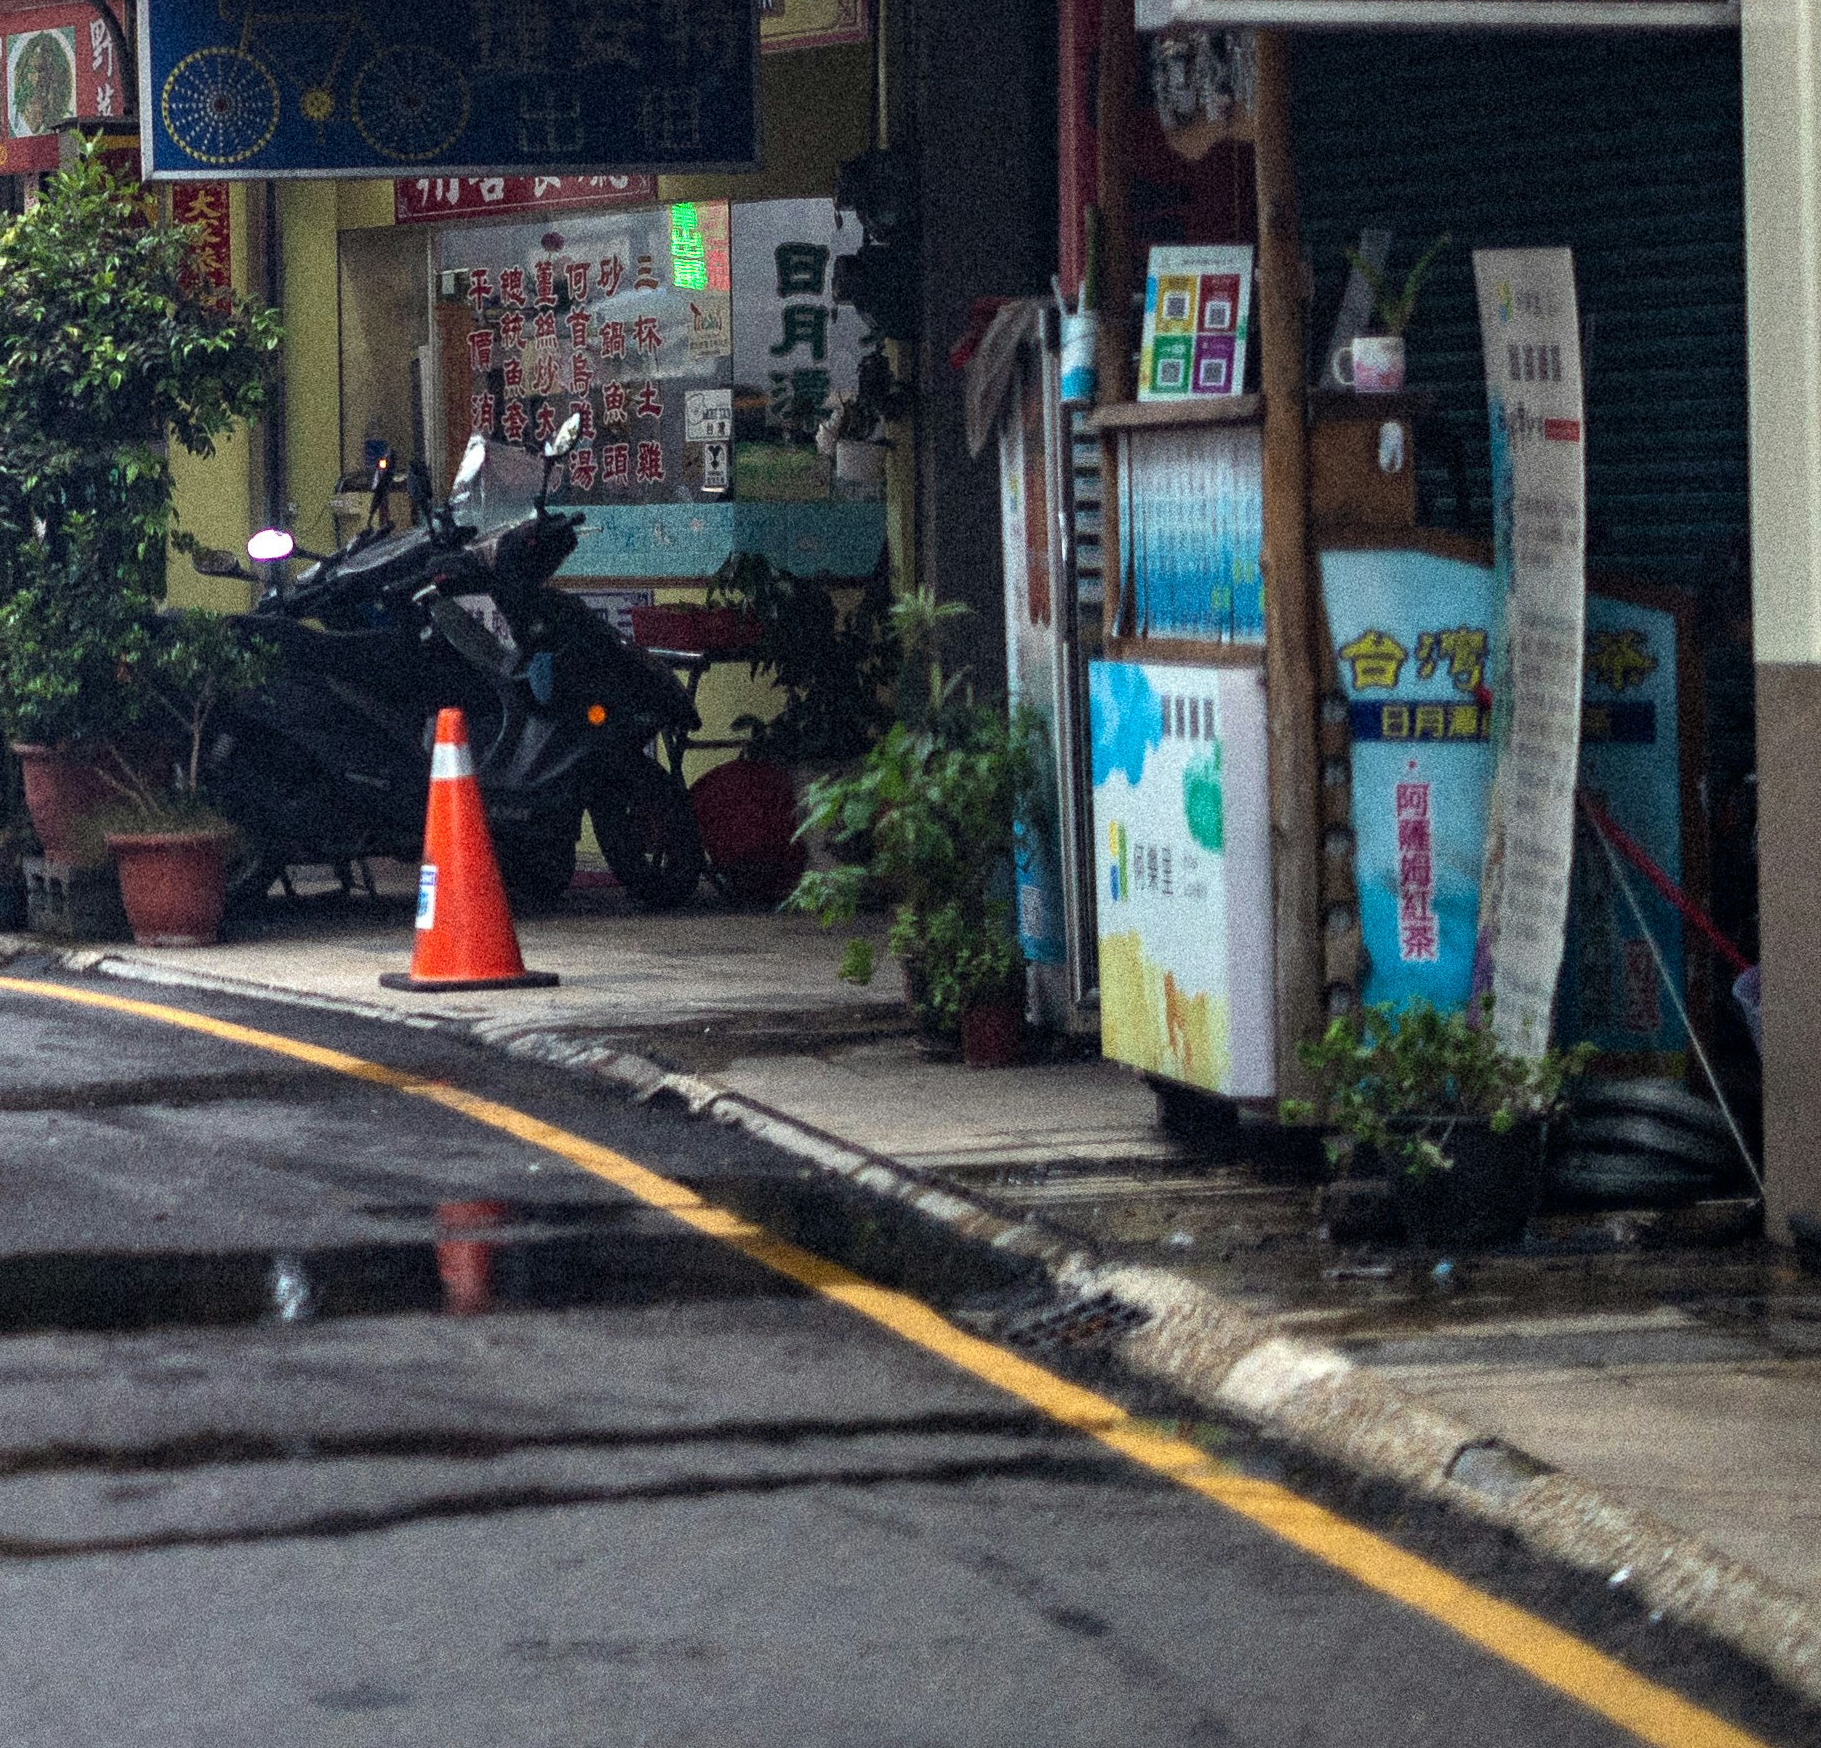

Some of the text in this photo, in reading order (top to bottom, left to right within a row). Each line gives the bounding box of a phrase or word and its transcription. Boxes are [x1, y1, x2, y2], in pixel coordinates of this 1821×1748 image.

[597, 255, 629, 485] 砂鍋魚頭
[633, 255, 666, 484] 三杯土雞
